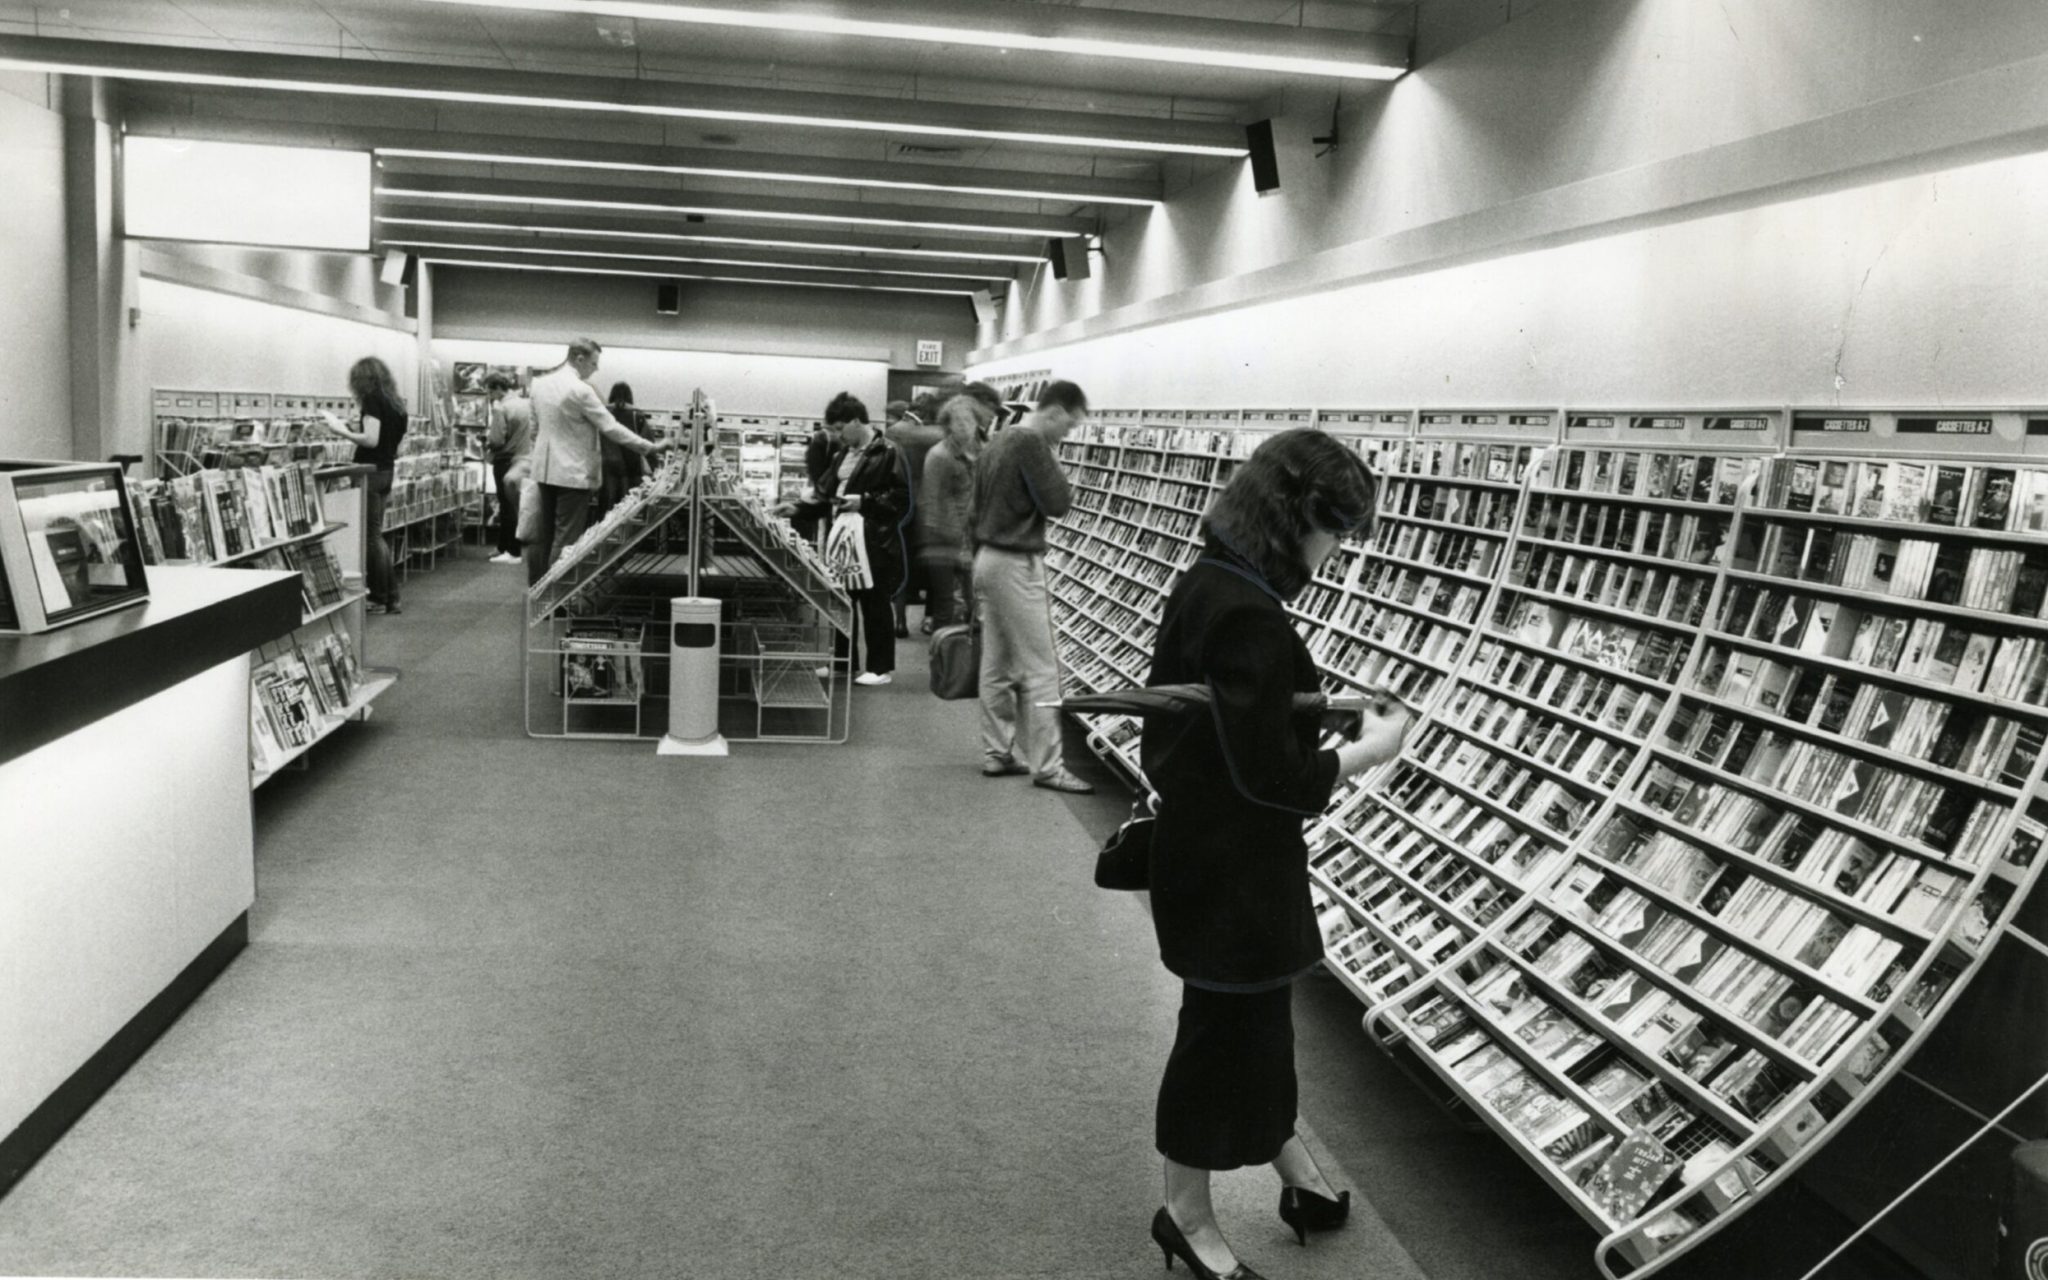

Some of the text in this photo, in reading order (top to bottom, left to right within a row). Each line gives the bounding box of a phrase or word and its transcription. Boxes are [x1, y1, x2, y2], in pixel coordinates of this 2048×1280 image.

[919, 350, 939, 363] EXIT
[1823, 419, 1869, 431] CASSETTES A-Z
[1936, 420, 1991, 433] CASSETTES A-Z
